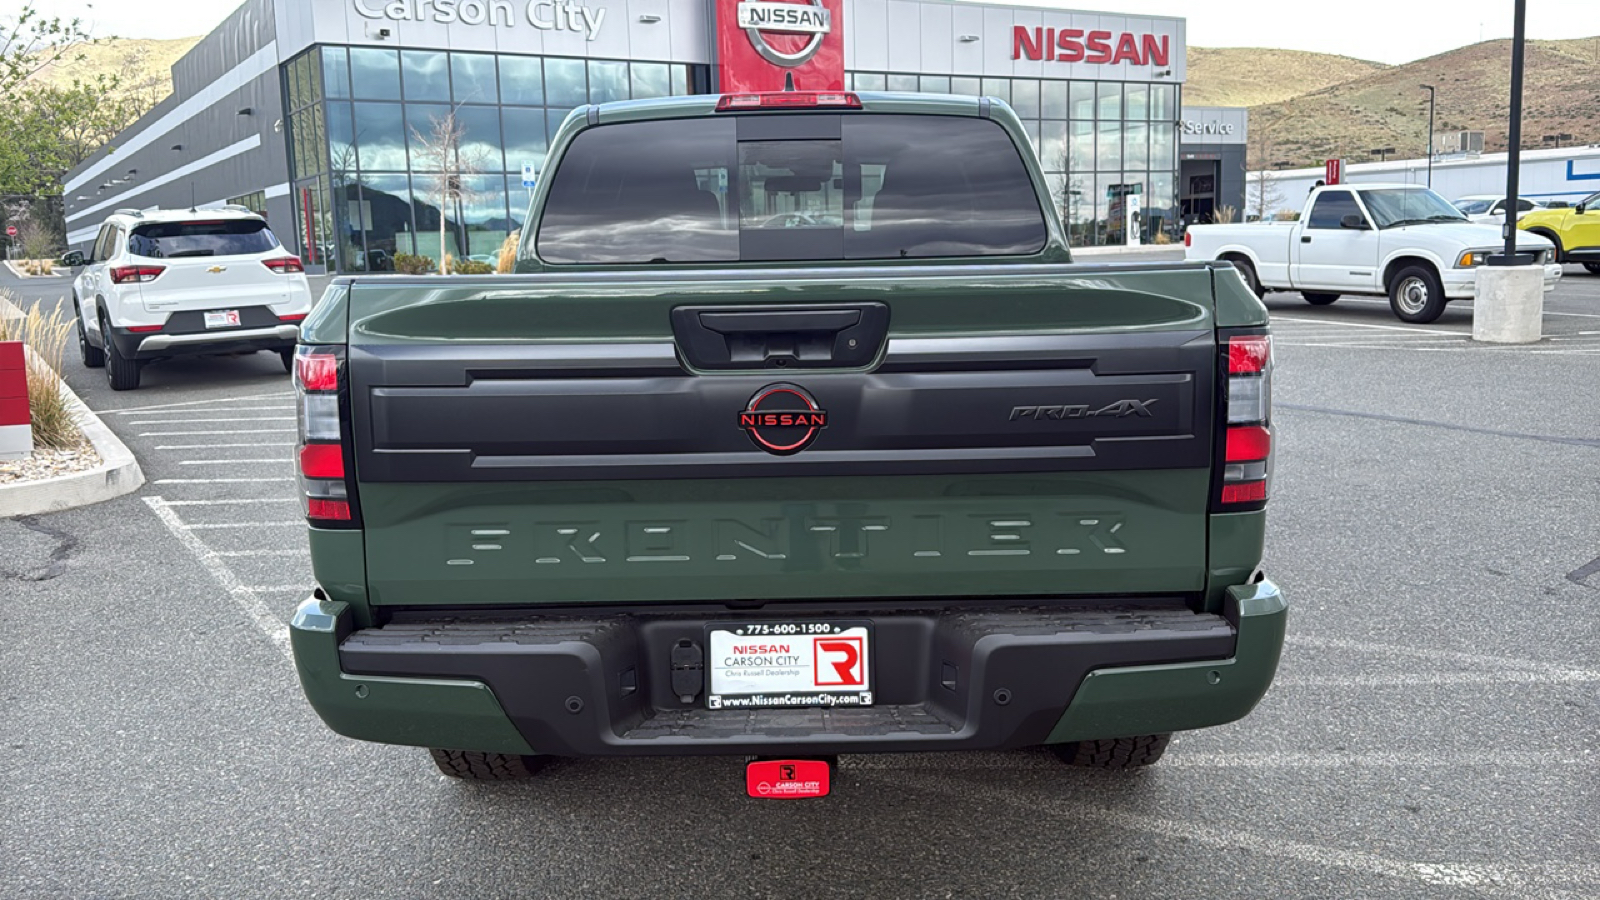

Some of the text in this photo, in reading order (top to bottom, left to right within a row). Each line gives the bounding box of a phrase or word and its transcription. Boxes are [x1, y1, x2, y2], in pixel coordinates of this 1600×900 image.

[354, 0, 606, 41] Carson City
[750, 8, 824, 27] NISSAN
[1011, 25, 1170, 67] NISSAN
[1184, 119, 1235, 135] Service
[1009, 398, 1159, 421] PRO-4X
[741, 414, 825, 426] NISSAN
[444, 511, 1128, 566] FRONTIER
[746, 623, 831, 635] 775-600-1500
[733, 644, 790, 655] NISSAN
[724, 655, 800, 667] CARSON CITY
[725, 669, 742, 677] Chris
[766, 668, 800, 677] Dealership
[723, 693, 859, 706] www.NissanCarsonCity.com
